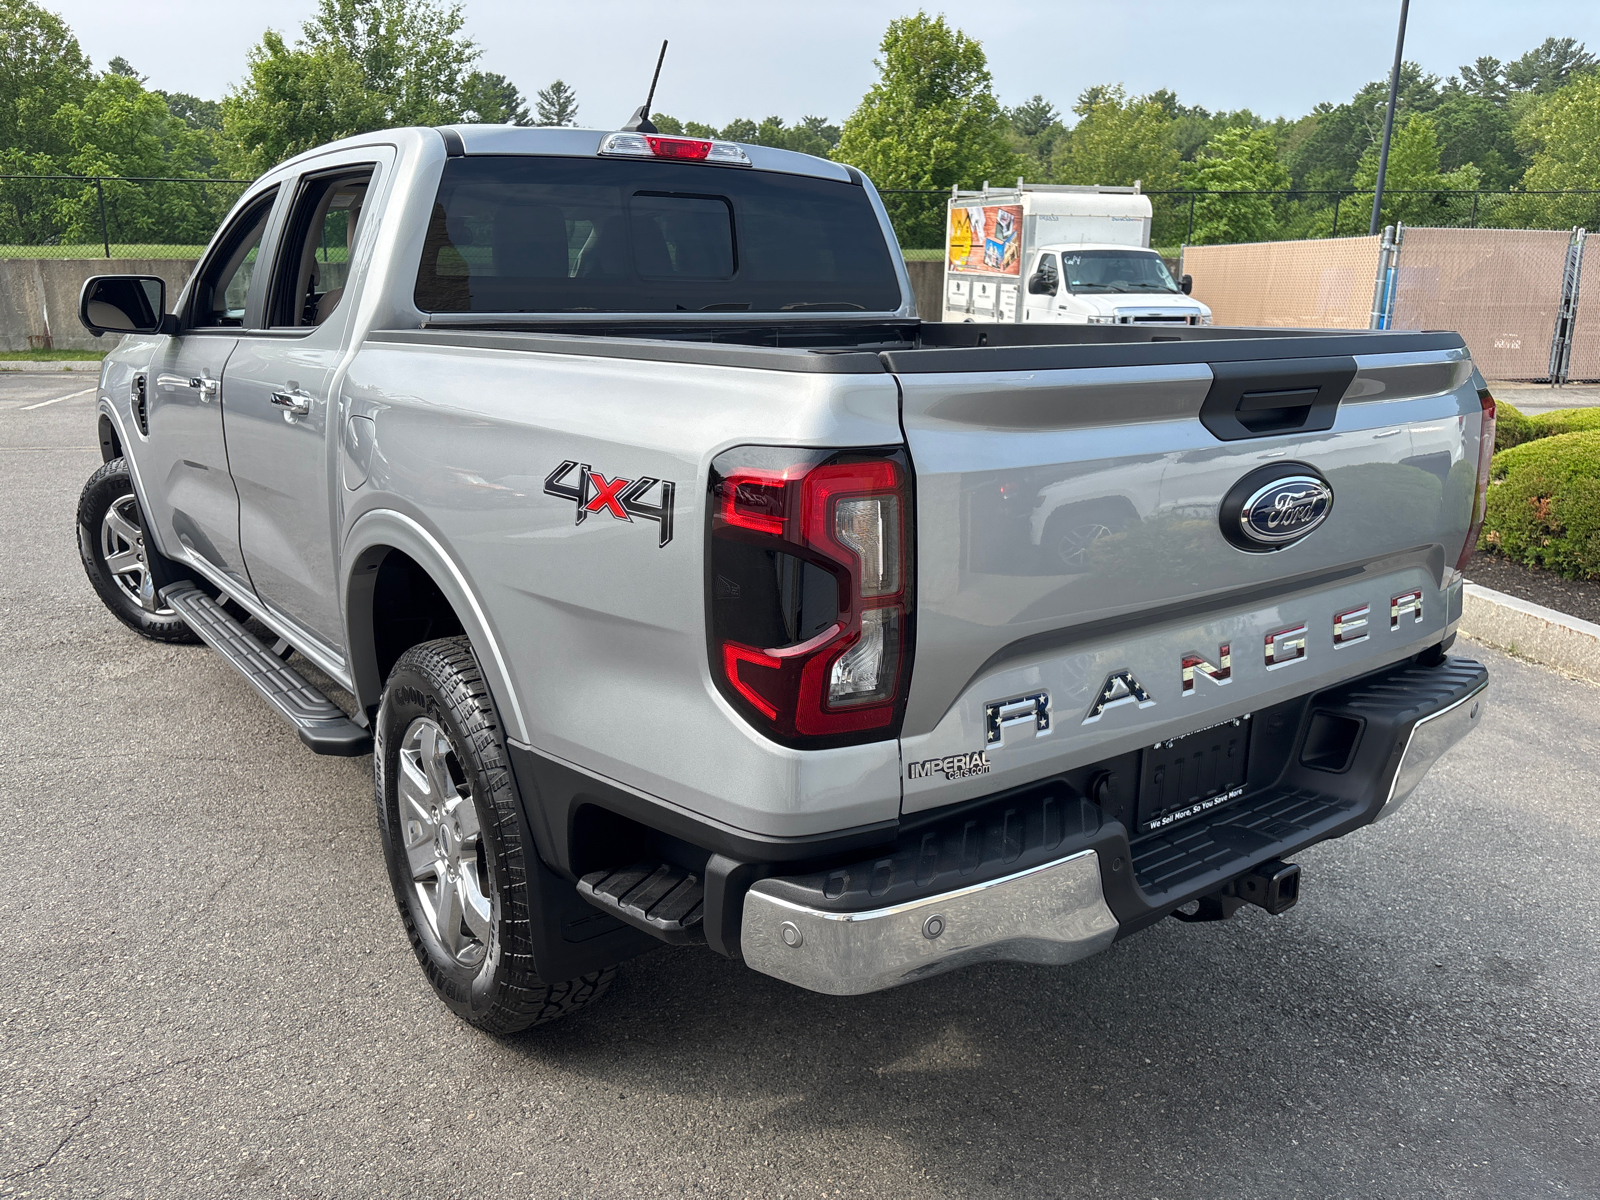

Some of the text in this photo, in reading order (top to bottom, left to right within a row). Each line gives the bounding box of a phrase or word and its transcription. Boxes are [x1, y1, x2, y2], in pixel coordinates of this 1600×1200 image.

[1266, 491, 1317, 529] Ford
[984, 588, 1424, 750] RANGER
[908, 750, 991, 779] IMPERIAL
[946, 764, 991, 780] cars.com
[1149, 788, 1243, 830] We Sell More, So You Save More
